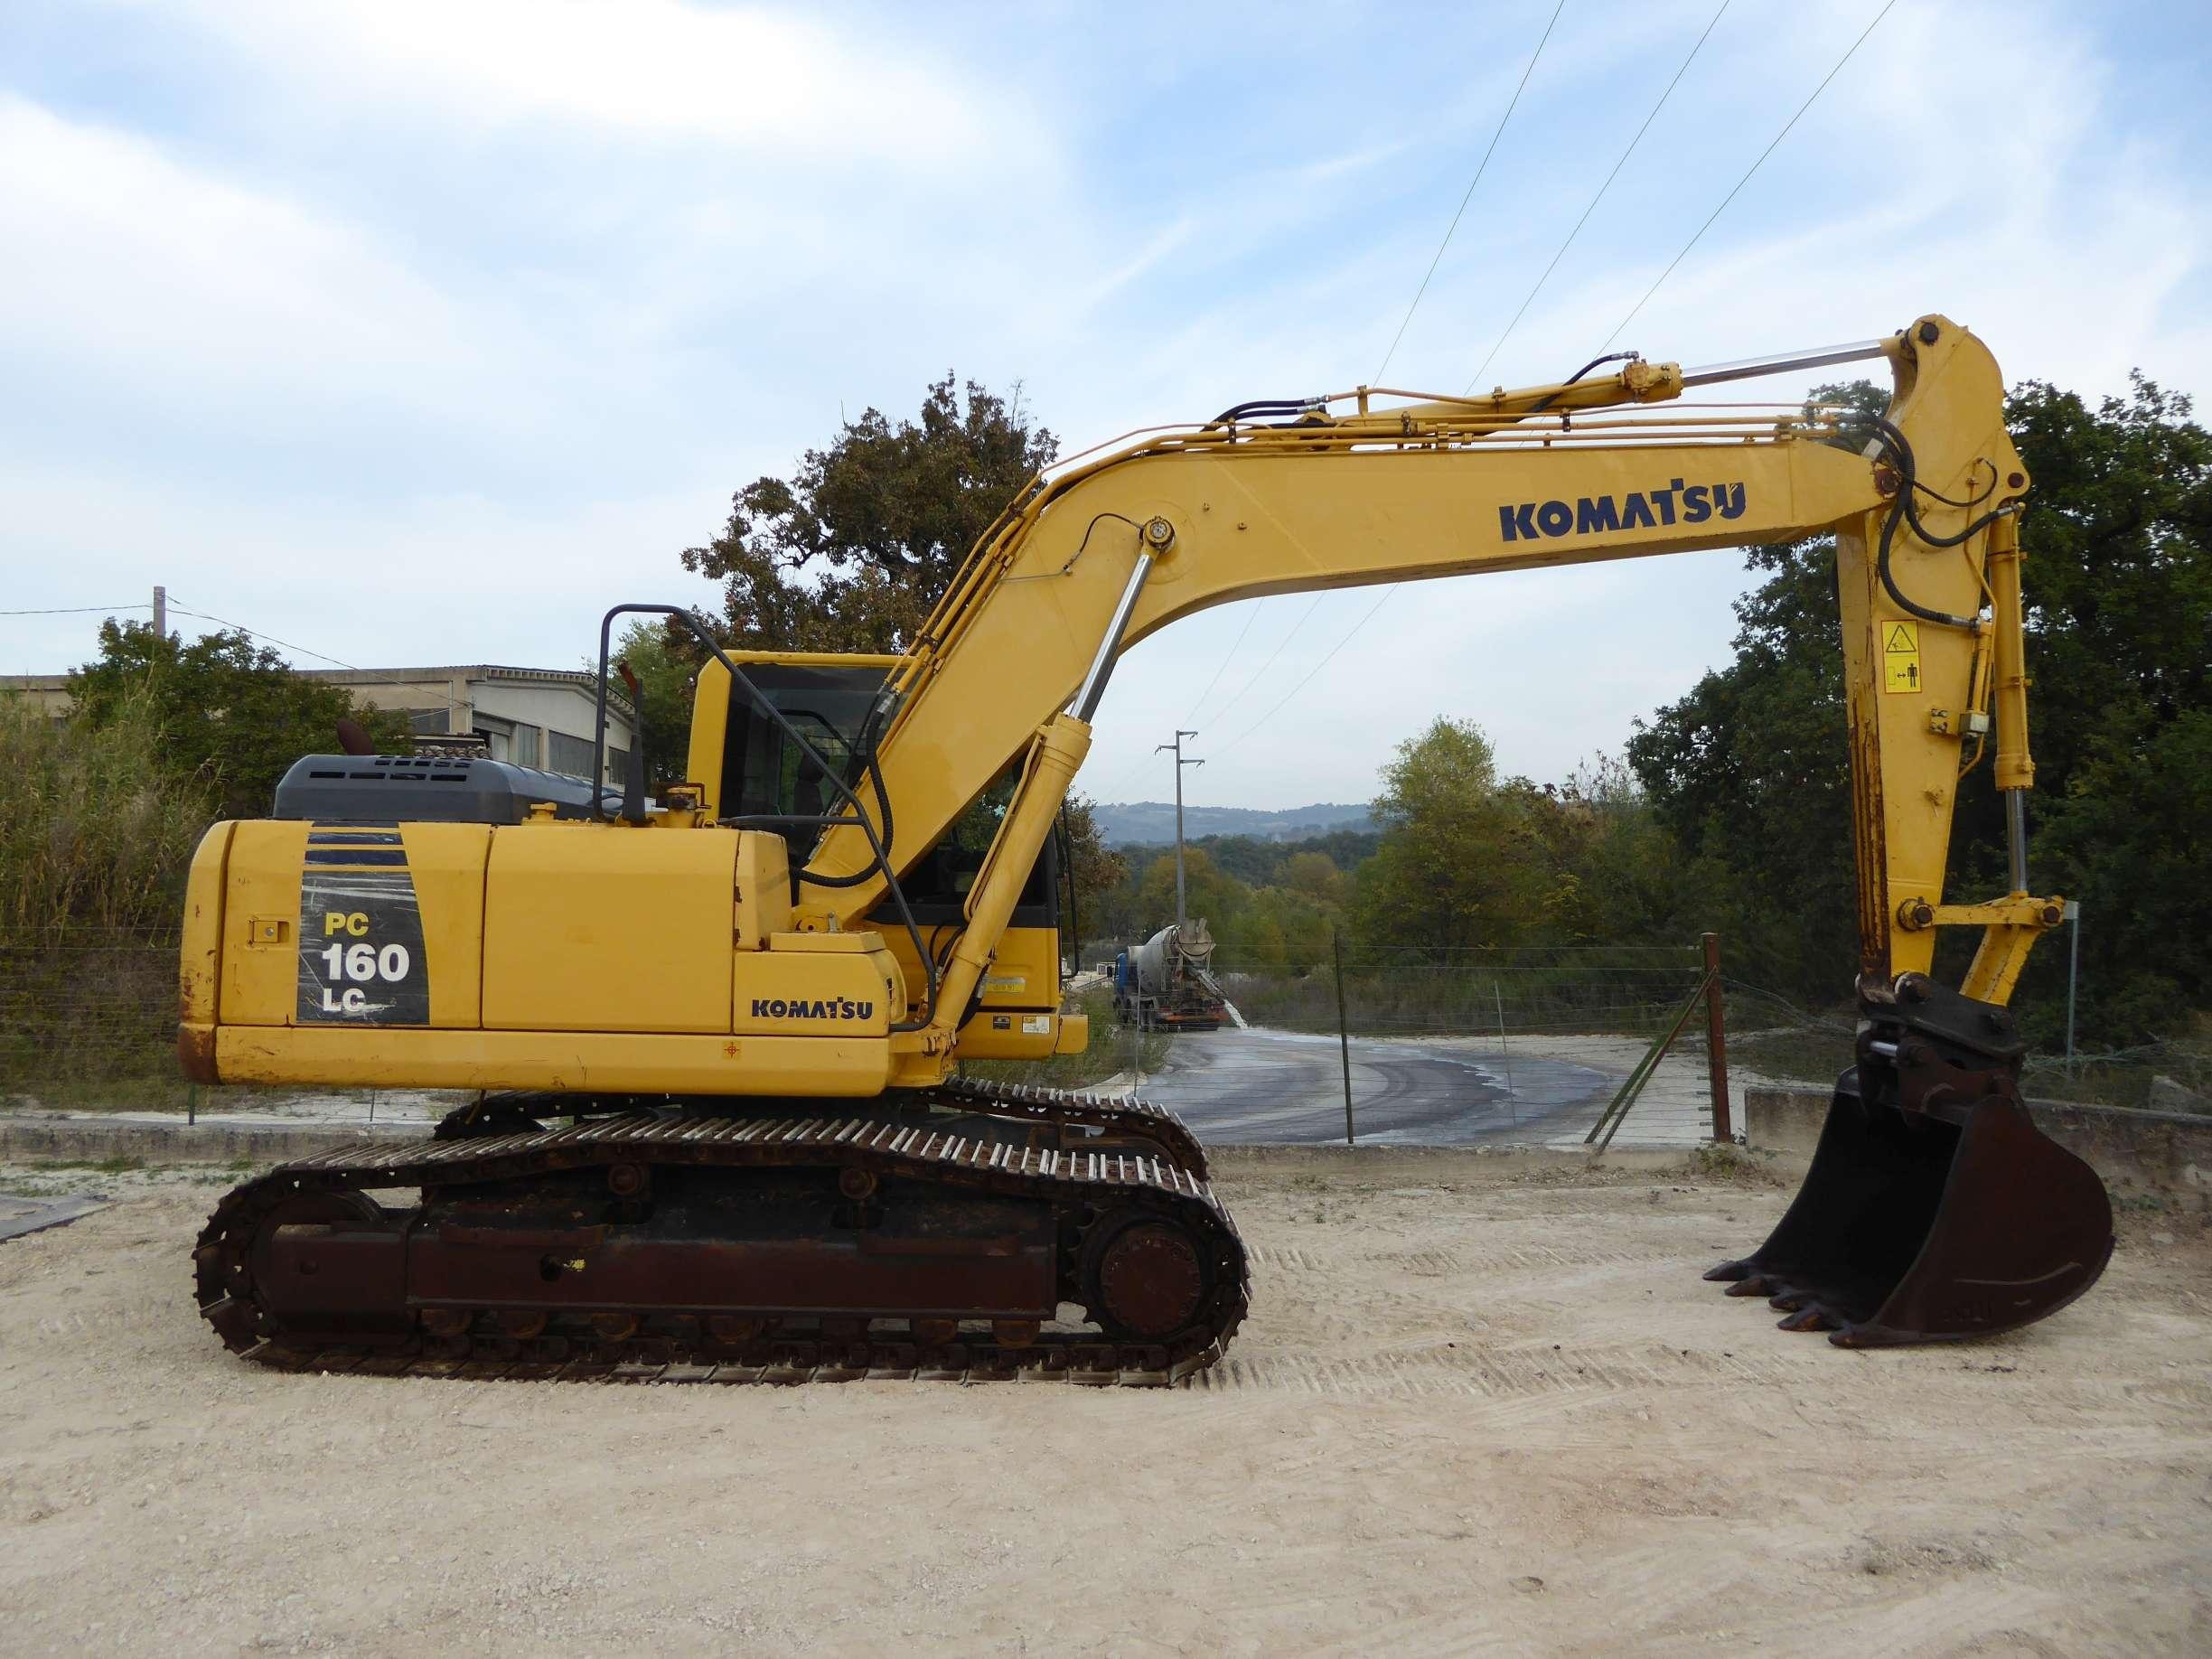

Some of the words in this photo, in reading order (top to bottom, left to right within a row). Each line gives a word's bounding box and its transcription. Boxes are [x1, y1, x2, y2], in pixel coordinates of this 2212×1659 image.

[1498, 477, 1747, 542] KOMATSU
[324, 912, 370, 937] PC
[322, 942, 410, 982] 160
[323, 988, 366, 1012] LC
[751, 996, 873, 1020] KOMATSU
